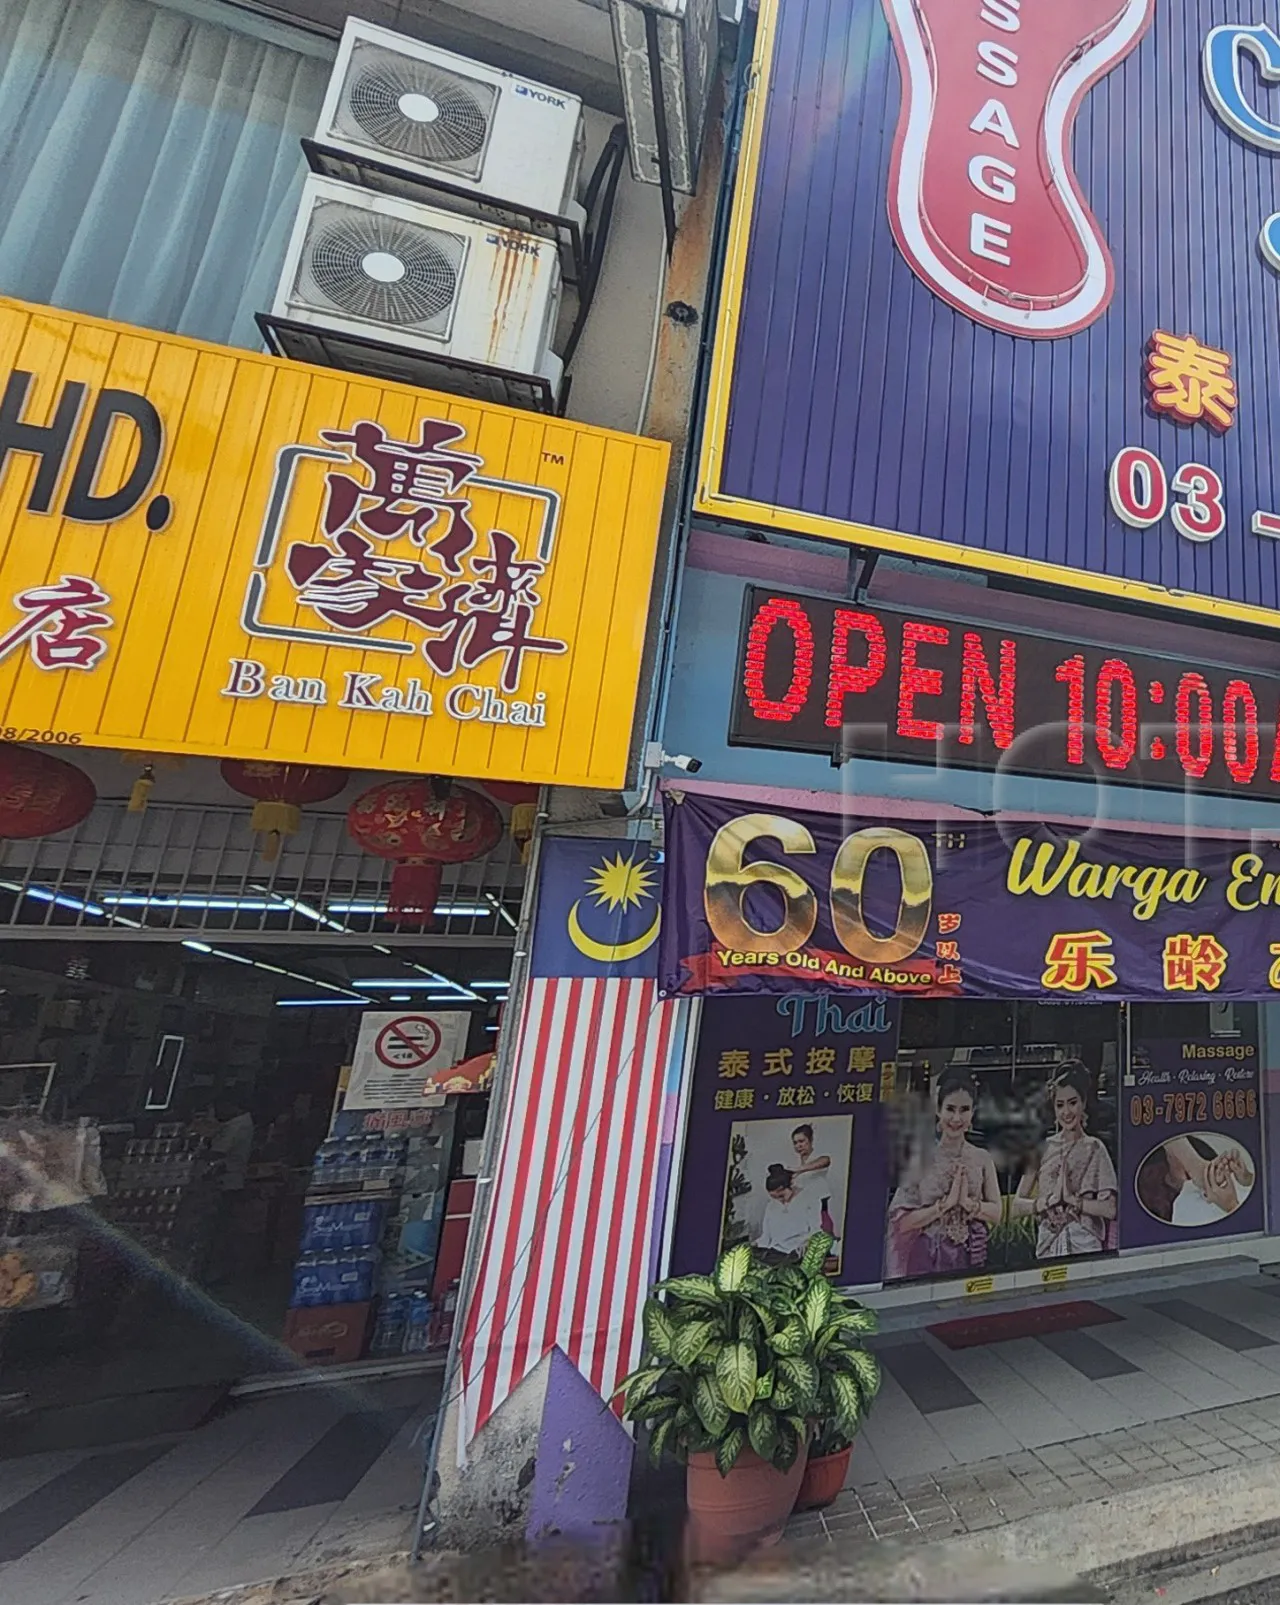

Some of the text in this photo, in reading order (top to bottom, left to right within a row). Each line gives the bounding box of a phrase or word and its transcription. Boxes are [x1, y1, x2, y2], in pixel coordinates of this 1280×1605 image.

[528, 89, 566, 110] YORK
[501, 235, 541, 257] YORK
[541, 452, 565, 465] TM
[0, 575, 113, 670] 店
[744, 598, 1016, 750] OPEN
[222, 659, 548, 728] Ban Kah Chai
[0, 727, 83, 745] 8/2006
[704, 813, 966, 964] 60 TH
[1007, 837, 1207, 921] Warga
[717, 948, 932, 985] Years Old And Above
[936, 912, 963, 985] 岁以上
[777, 994, 892, 1037] Thai
[718, 1046, 876, 1079] 泰式按摩
[1182, 1043, 1255, 1061] Massage
[1130, 1089, 1257, 1126] 03-7972 6666
